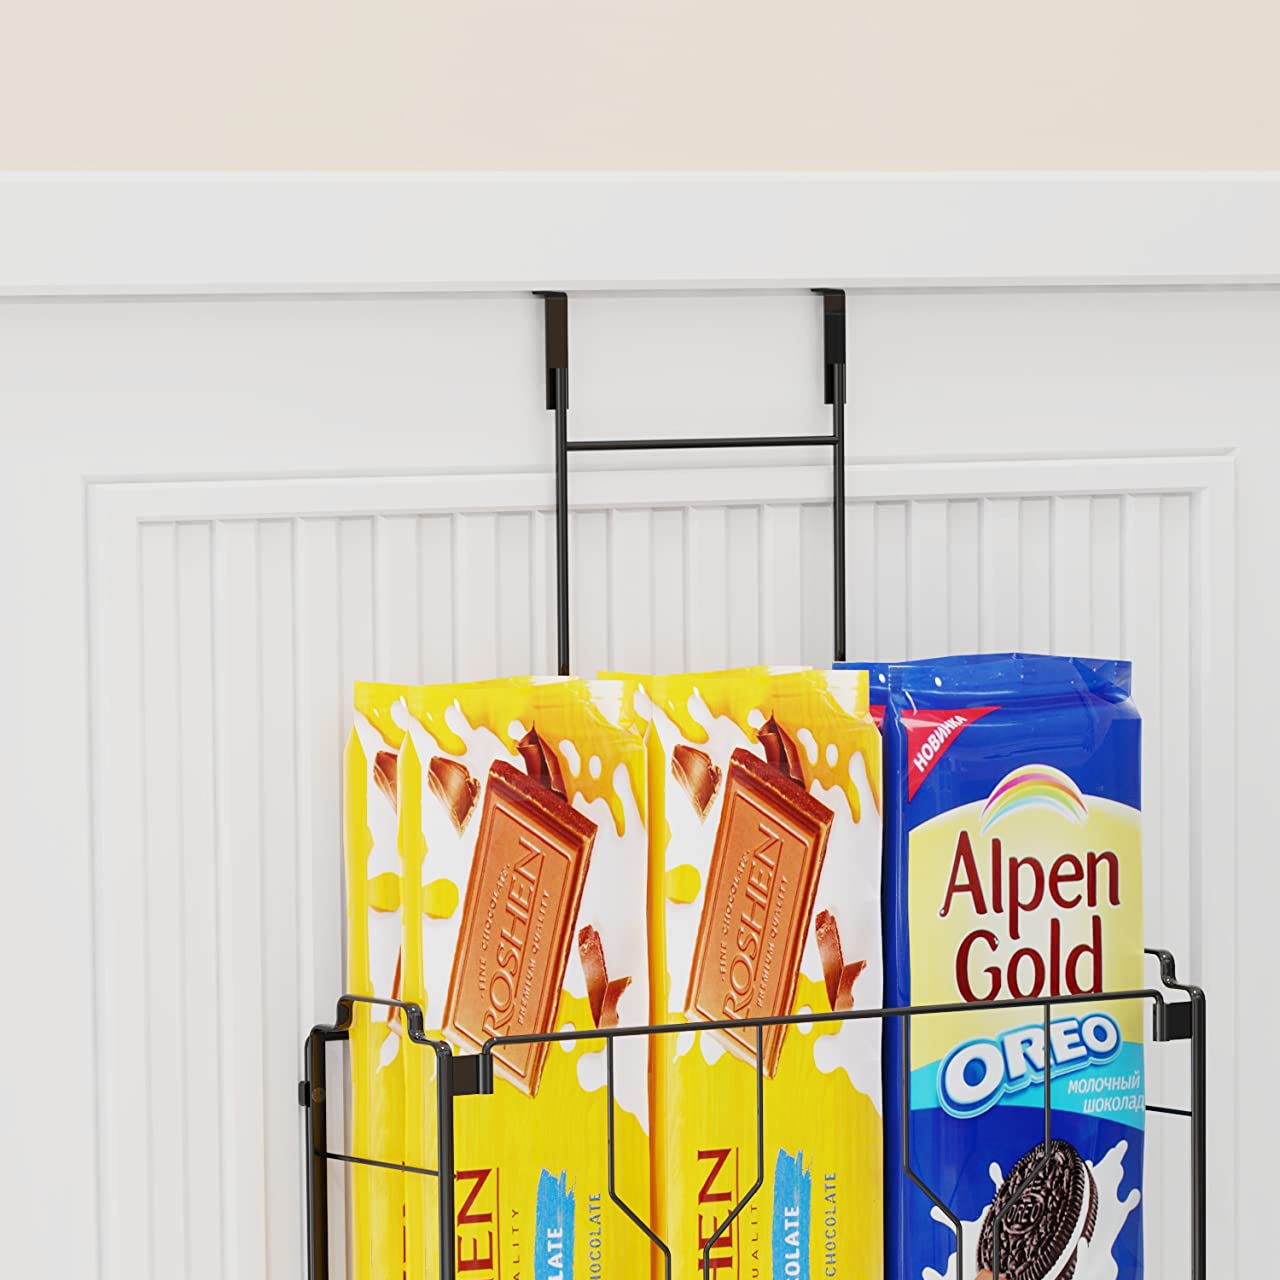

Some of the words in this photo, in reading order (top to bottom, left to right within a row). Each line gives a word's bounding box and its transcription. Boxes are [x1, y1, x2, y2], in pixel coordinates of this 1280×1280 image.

[913, 715, 968, 773] НОВИНКА
[481, 836, 546, 1041] ROSHEN
[722, 822, 784, 1022] ROSHEN
[939, 830, 1121, 941] Alpen
[518, 958, 537, 1026] PREMIUM
[532, 890, 550, 954] QUALITY
[757, 943, 776, 1009] PREMIUM
[770, 875, 789, 939] QUALITY
[955, 915, 1103, 1003] Gold
[945, 1016, 1118, 1105] OREO
[825, 1173, 837, 1278] CHOCOLATE
[1006, 1202, 1041, 1223] OREO
